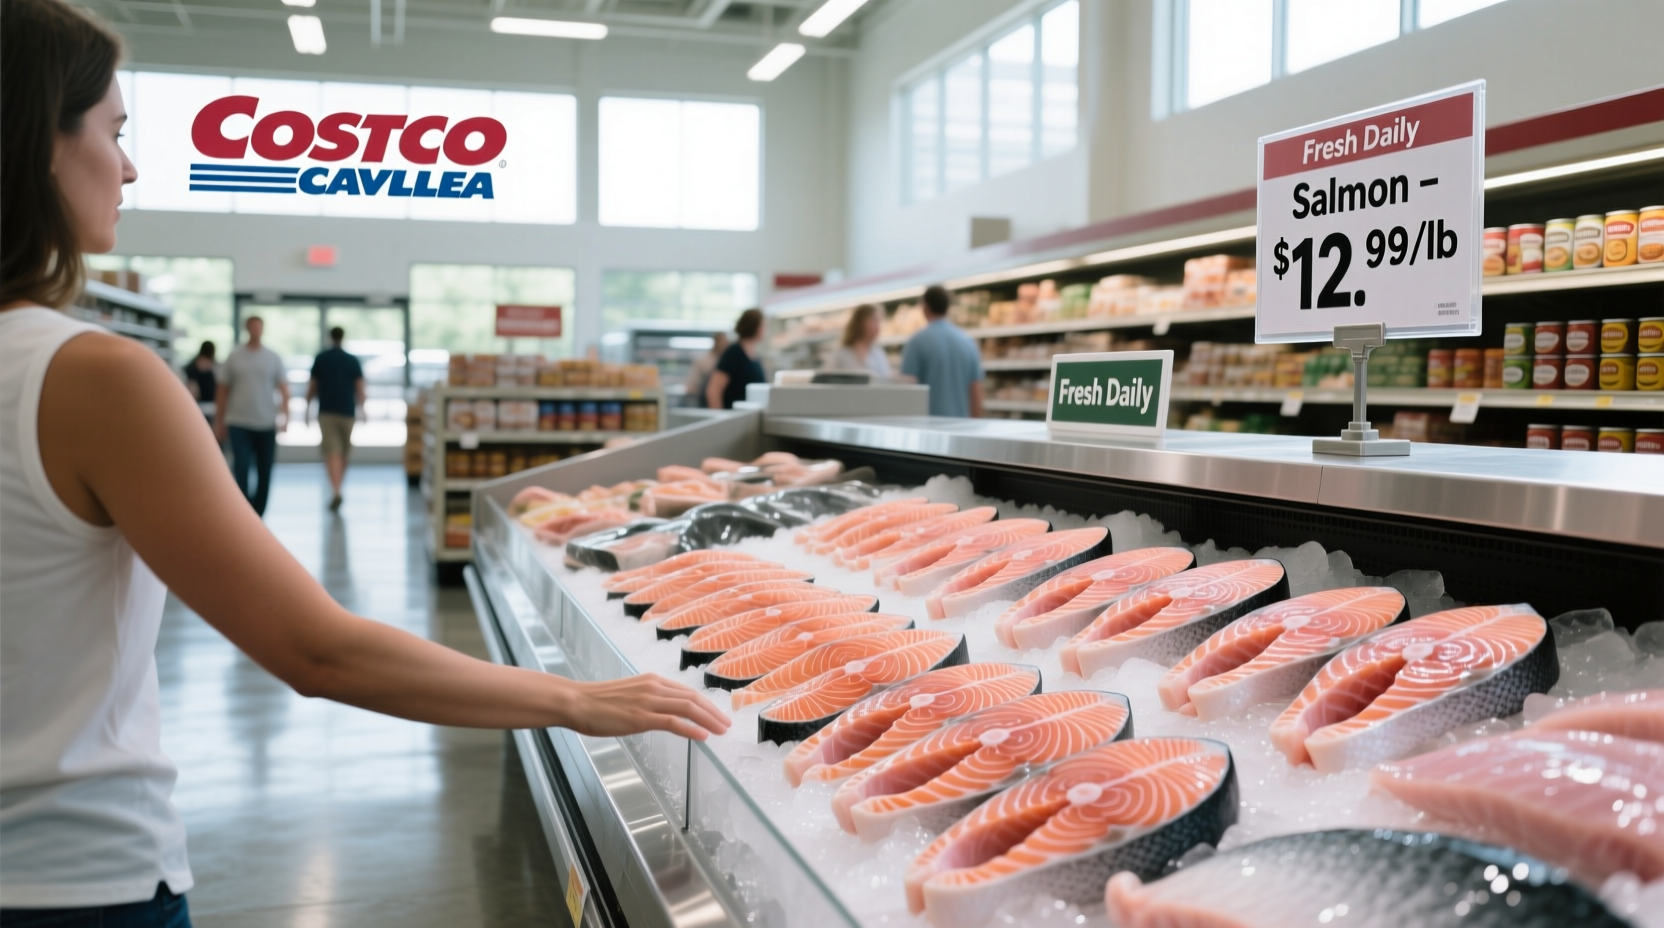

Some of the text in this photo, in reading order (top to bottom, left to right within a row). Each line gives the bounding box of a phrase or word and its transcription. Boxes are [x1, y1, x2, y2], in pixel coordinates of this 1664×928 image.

[1302, 116, 1421, 165] Fresh Daily
[298, 166, 494, 200] CAVLLEA
[1292, 174, 1409, 220] Salmon
[1058, 377, 1154, 415] Fresh Daily
